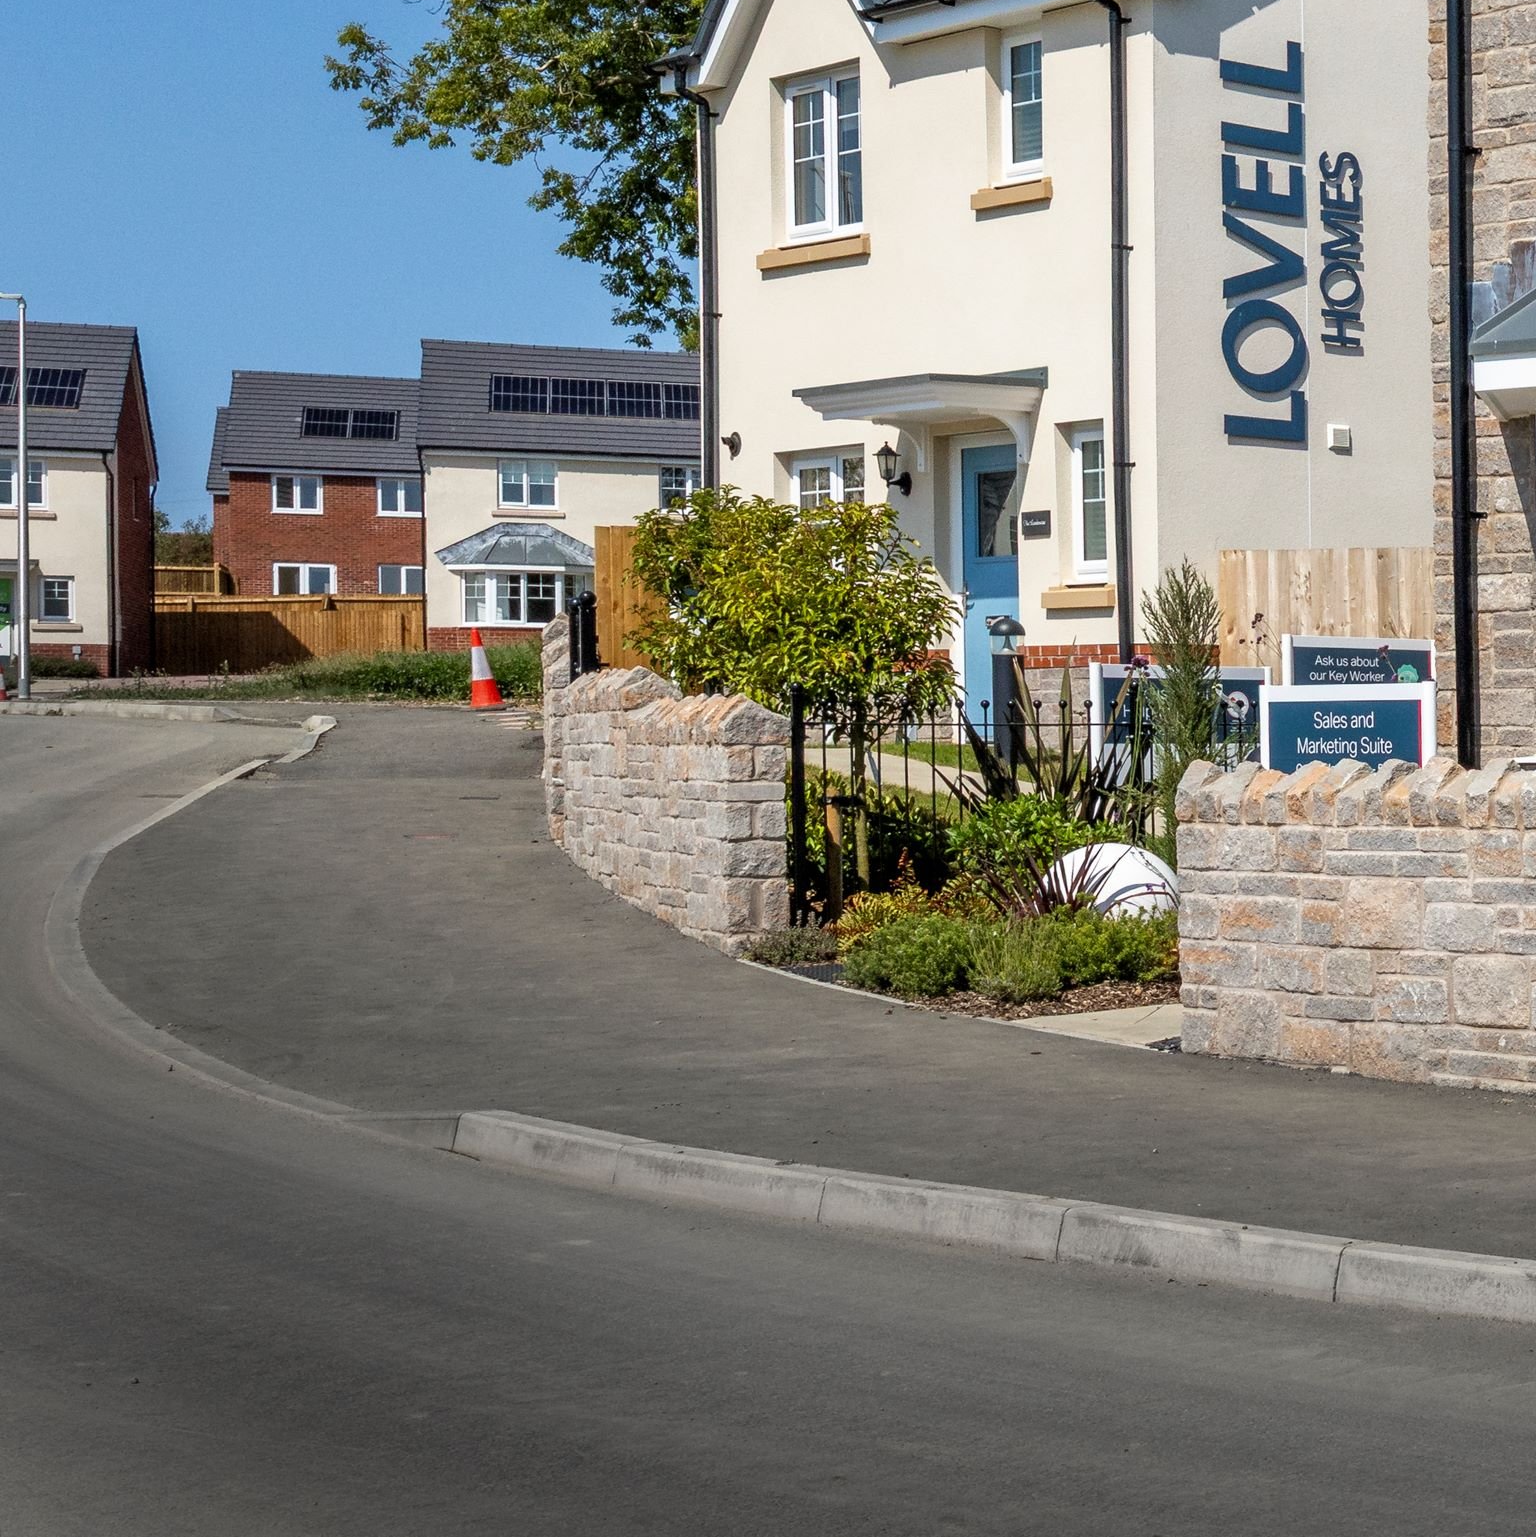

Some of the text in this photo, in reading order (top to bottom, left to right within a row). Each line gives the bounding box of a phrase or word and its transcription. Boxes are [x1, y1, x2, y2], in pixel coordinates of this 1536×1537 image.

[1219, 40, 1306, 442] LOVELL
[1318, 150, 1361, 348] HOMES
[1314, 654, 1380, 668] Ask us about
[1309, 670, 1385, 683] our Key Worker
[1313, 711, 1375, 729] Sales and
[1296, 736, 1393, 758] Marketing Suite
